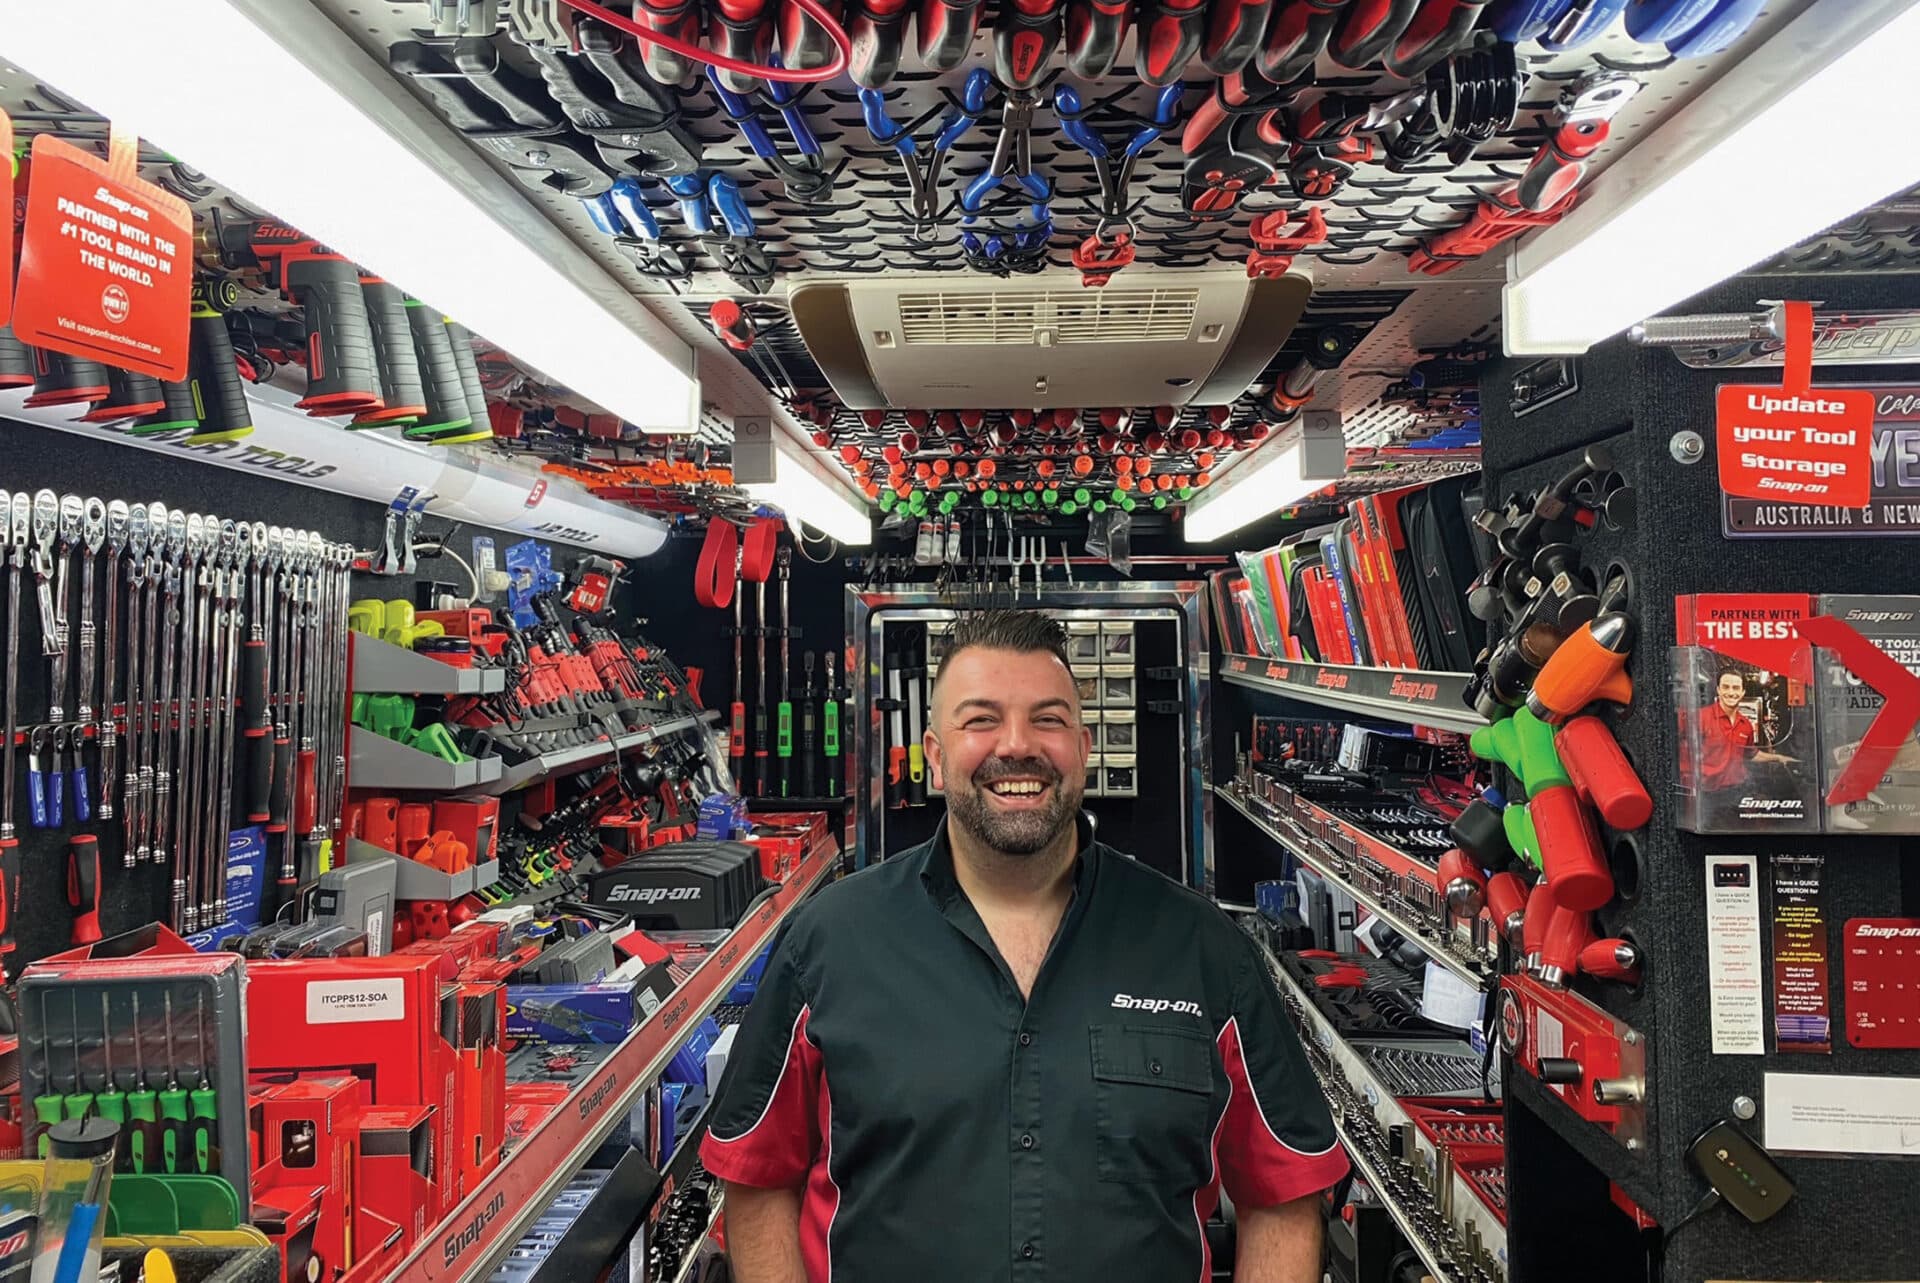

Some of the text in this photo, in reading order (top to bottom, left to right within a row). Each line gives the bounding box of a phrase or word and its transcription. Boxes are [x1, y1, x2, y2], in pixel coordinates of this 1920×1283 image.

[94, 187, 149, 222] Snap-on
[57, 197, 175, 256] PARTNER WITH THE
[61, 221, 171, 274] #1 TOOL BRAND IN
[80, 249, 153, 287] THE WORLD.
[57, 317, 161, 354] Visit snaponfranchise.com.au
[1813, 319, 1914, 355] nap
[1747, 394, 1846, 415] Update
[1734, 427, 1856, 446] your Tool
[230, 444, 338, 478] TOOLS
[1740, 453, 1847, 476] Storage
[1757, 477, 1829, 494] Snap-on
[1755, 505, 1920, 526] AUSTRALIA & NEW
[1711, 609, 1800, 620] PARTNER WITH
[1844, 609, 1914, 622] Snap-on
[1704, 621, 1799, 639] THE BEST
[1316, 667, 1348, 692] Snap-on
[1390, 674, 1439, 702] Snap-on
[1738, 798, 1803, 810] Snap-on
[606, 884, 701, 904] Snap-on
[1855, 924, 1920, 939] Snap-on
[321, 993, 388, 1004] ITCPPS12-SOA
[1111, 993, 1200, 1014] Snap-on
[579, 1073, 616, 1120] Snap-on
[443, 1191, 505, 1270] Snap-on
